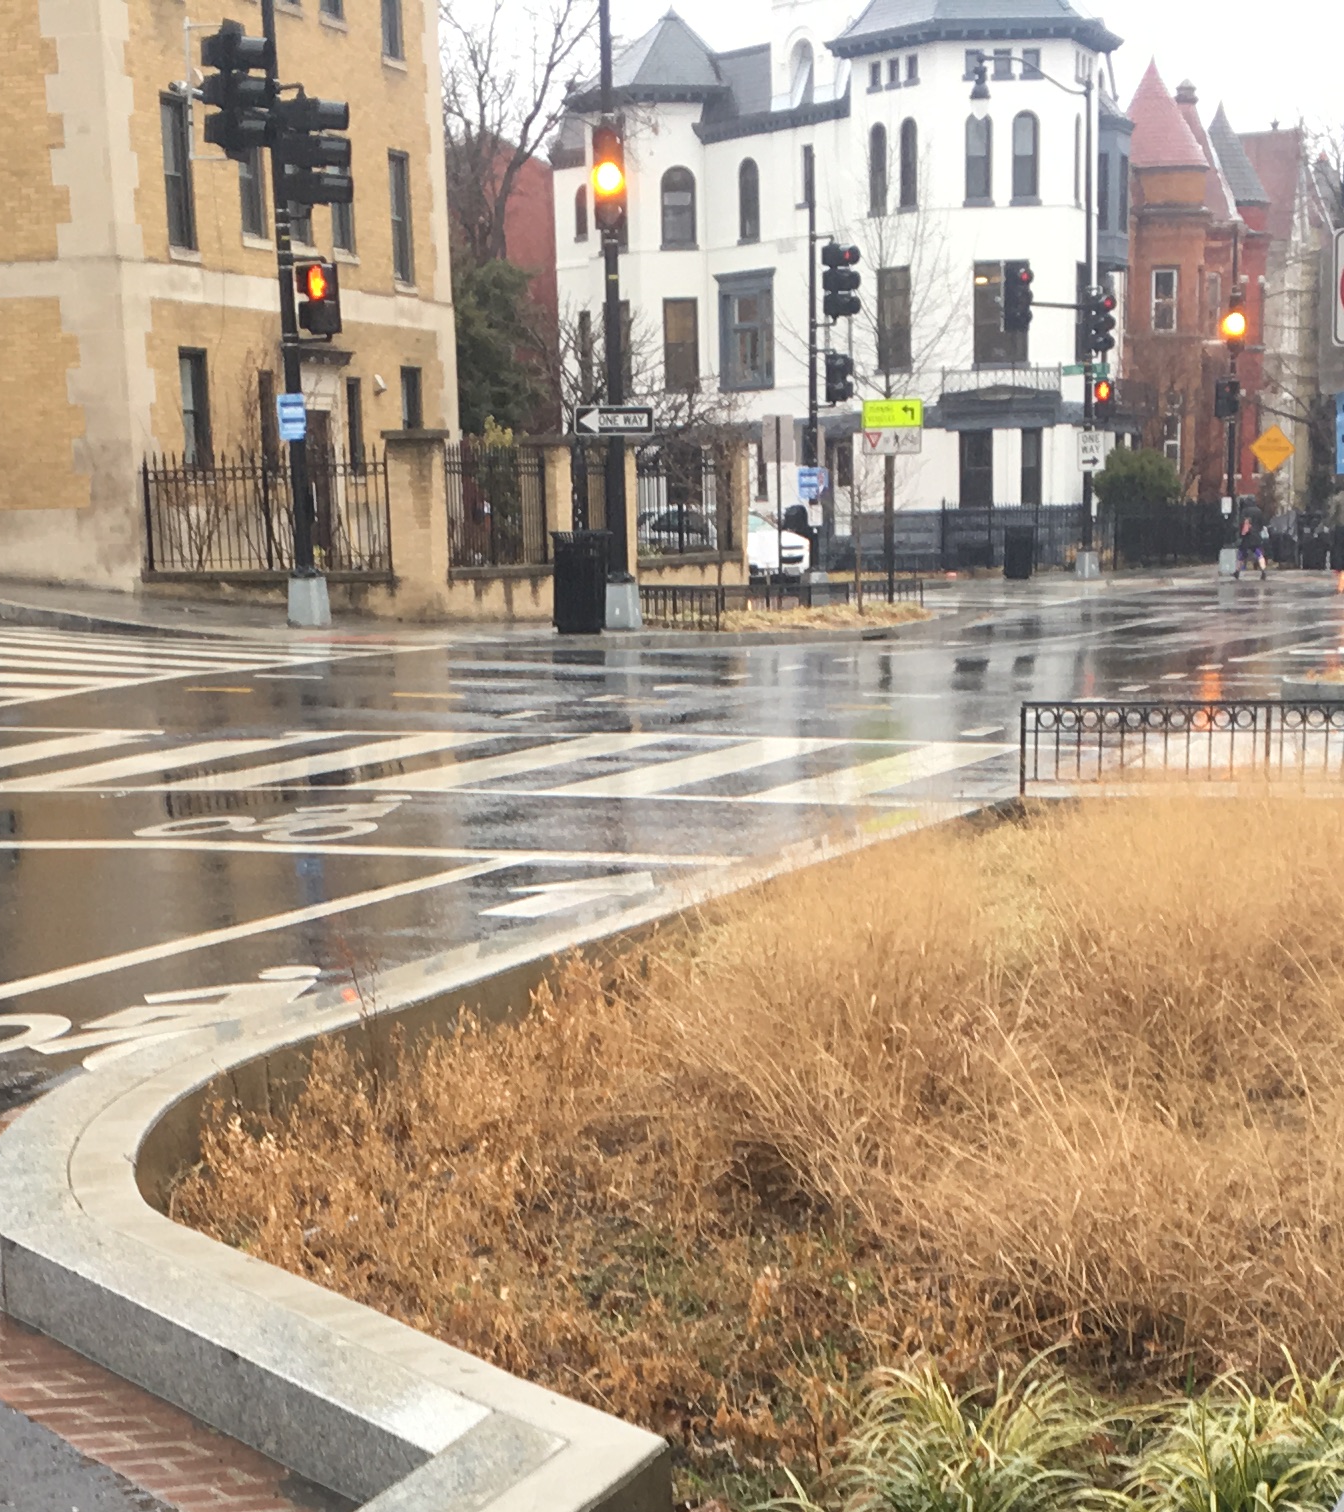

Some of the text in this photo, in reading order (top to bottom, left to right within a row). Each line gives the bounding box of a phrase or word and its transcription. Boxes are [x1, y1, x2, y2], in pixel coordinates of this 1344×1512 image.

[598, 414, 645, 426] ONE WAY
[1081, 434, 1101, 444] ONE
[1081, 445, 1102, 455] WAY
